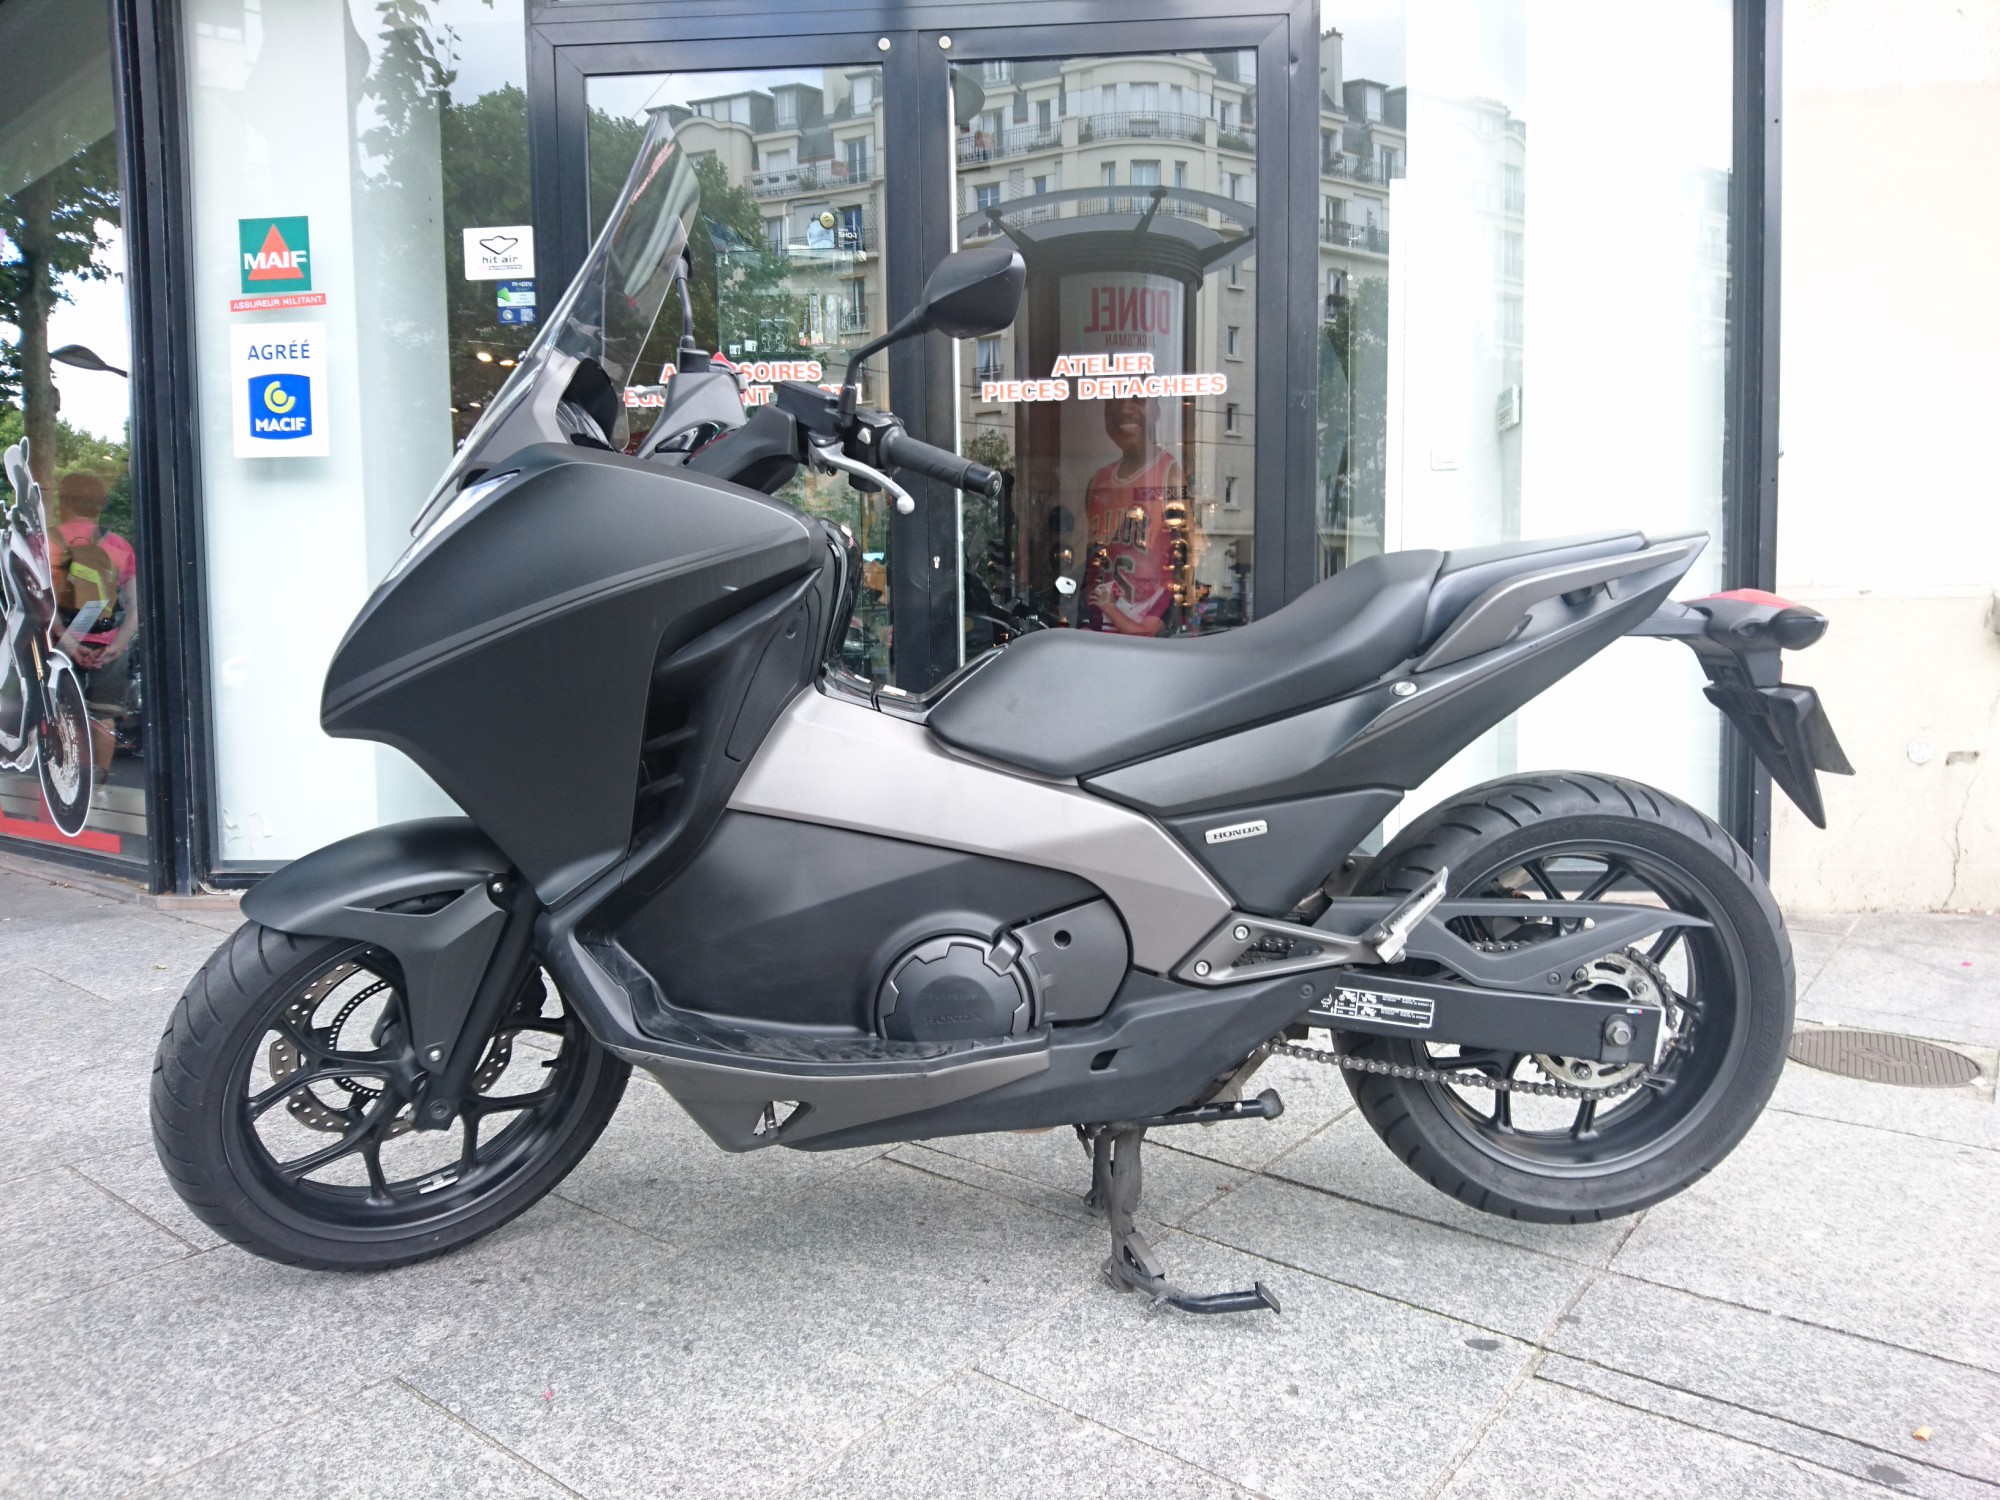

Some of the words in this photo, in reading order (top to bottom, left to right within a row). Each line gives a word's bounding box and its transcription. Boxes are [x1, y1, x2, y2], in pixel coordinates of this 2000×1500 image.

[243, 250, 307, 270] MAIF
[233, 298, 280, 310] ASSUREUR
[247, 339, 311, 361] AGRÉÉ
[1051, 353, 1154, 377] ATELIER
[982, 380, 1069, 402] PIECES
[1078, 373, 1227, 400] DETACHEES
[255, 417, 306, 432] MACIF
[1213, 825, 1261, 840] HONDA
